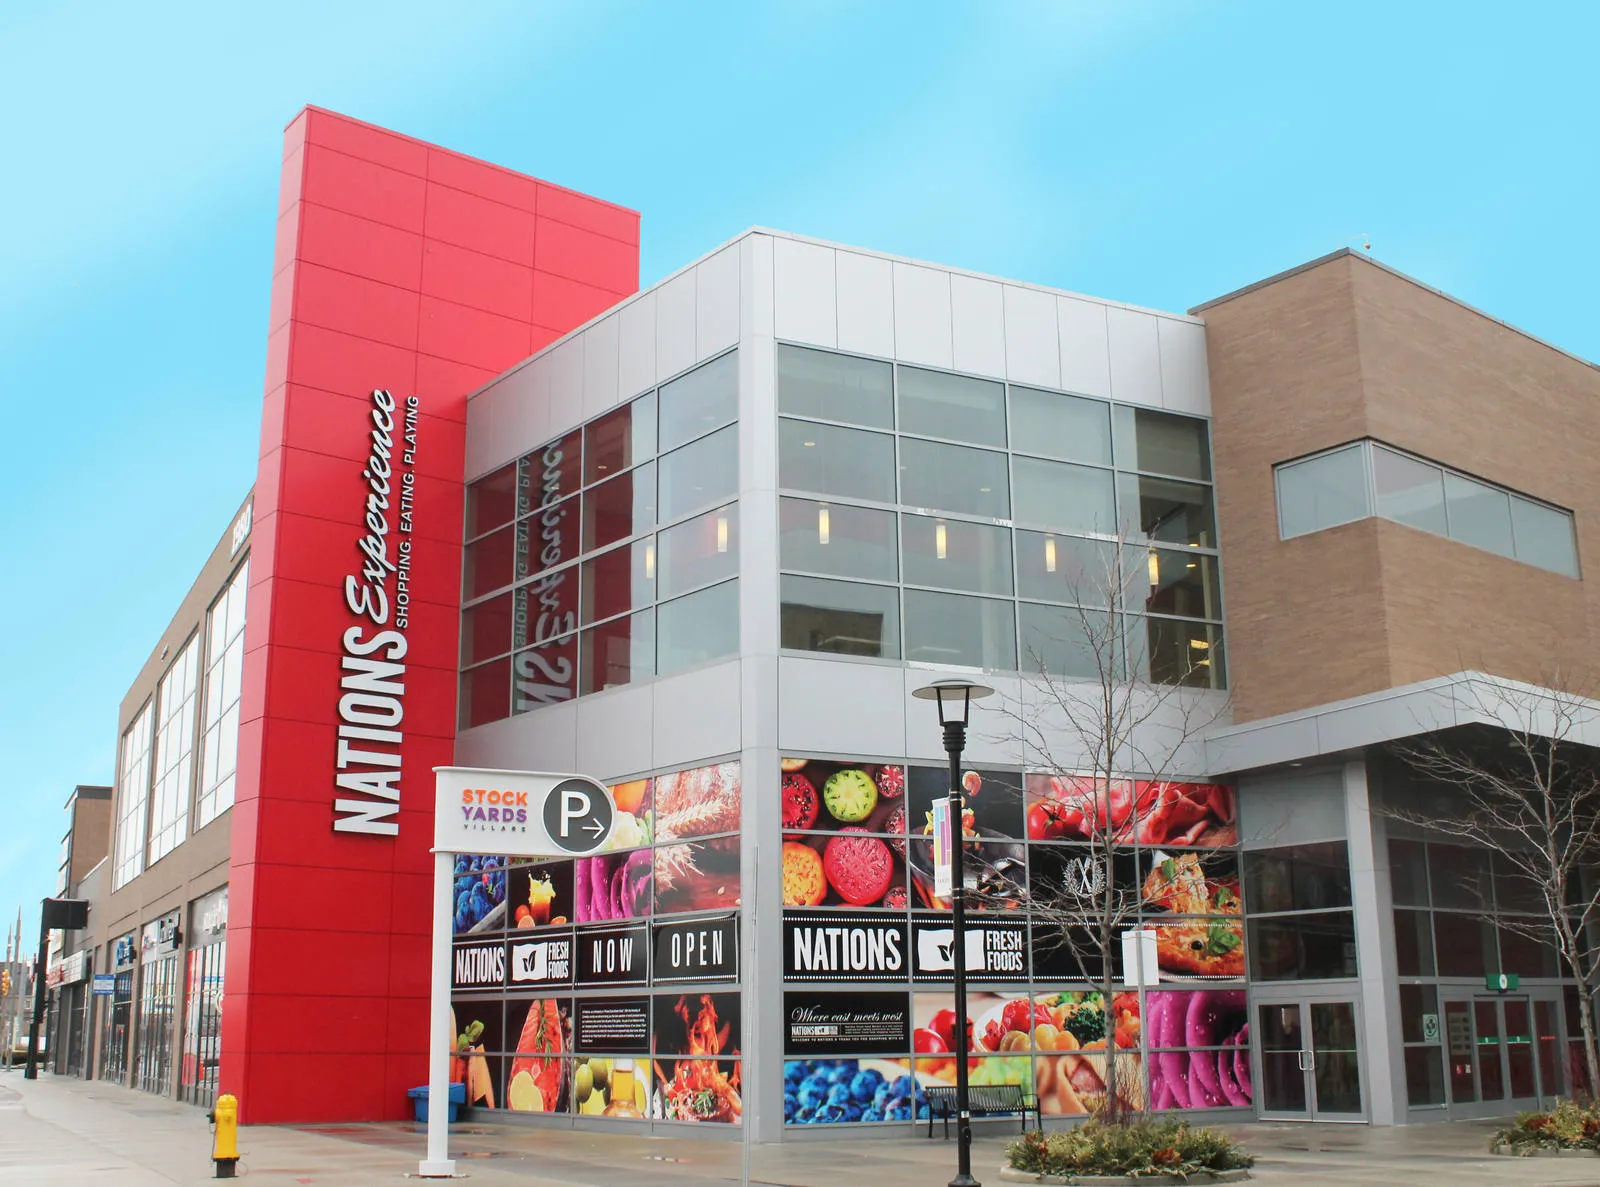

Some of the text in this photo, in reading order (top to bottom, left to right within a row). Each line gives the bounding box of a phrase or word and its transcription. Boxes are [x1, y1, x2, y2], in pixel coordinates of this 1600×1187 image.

[397, 395, 419, 629] SHOPPING. EATING. PLAYING
[333, 388, 408, 836] NATIONS Experience
[462, 788, 528, 806] STOCK
[462, 806, 527, 823] YARDS
[560, 790, 591, 837] P
[463, 824, 526, 832] VILLAGE
[548, 941, 569, 961] FRESH
[793, 927, 902, 971] NATIONS
[986, 930, 1022, 951] FRESH
[593, 930, 723, 973] NOW OPEN
[986, 950, 1023, 971] FOODS
[455, 946, 504, 984] NATIONS
[548, 960, 569, 979] FOODS
[791, 1004, 903, 1023] Where east meets west
[791, 1025, 815, 1036] NATIONS
